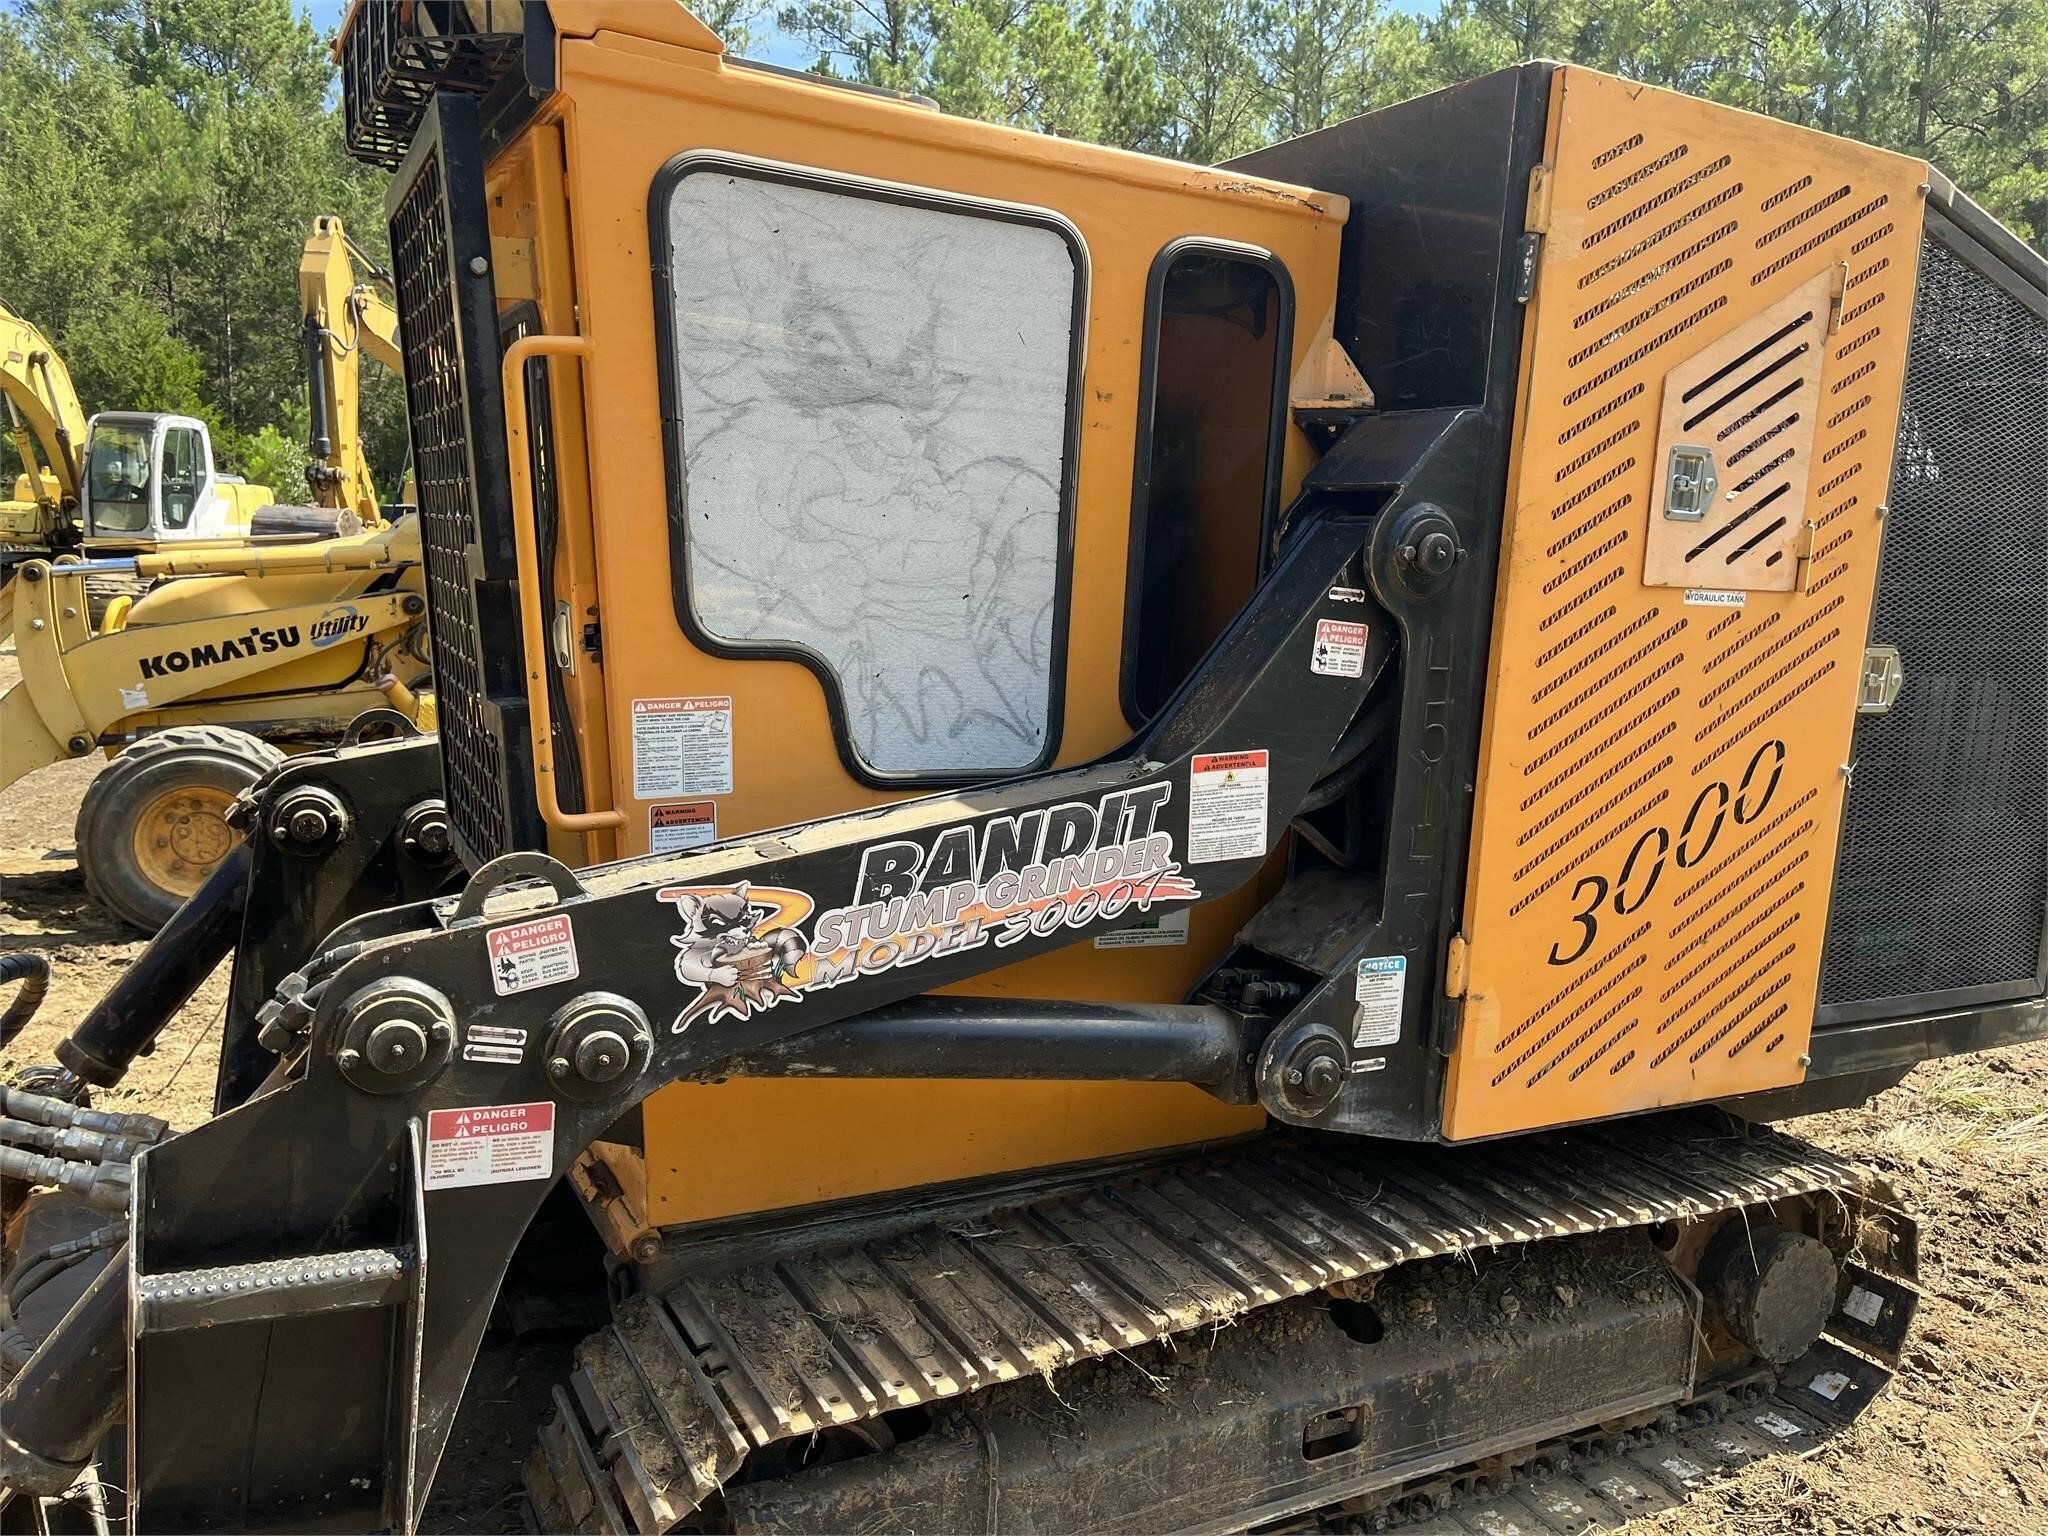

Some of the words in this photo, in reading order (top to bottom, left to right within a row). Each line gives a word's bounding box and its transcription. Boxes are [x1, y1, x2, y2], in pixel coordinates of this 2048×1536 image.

[1726, 595, 1744, 603] TANK
[1331, 624, 1364, 634] DANGER
[1330, 634, 1364, 644] PELIGRO
[139, 626, 300, 679] KOMATSU
[309, 614, 370, 641] Utility
[1211, 761, 1256, 770] ADVERTENCIA
[666, 816, 710, 824] ADVERTENCIA
[852, 781, 1172, 908] BANDIT
[1547, 740, 1786, 966] 3000
[814, 883, 976, 953] STUMP
[985, 836, 1169, 909] GRINDER
[510, 920, 563, 939] DANGER
[809, 916, 987, 987] MODEL
[999, 863, 1179, 942] 3000T
[512, 932, 566, 951] PELIGRO
[1366, 960, 1400, 970] NOTICE
[473, 1108, 526, 1120] DANGER
[472, 1122, 528, 1134] PELIGRO
